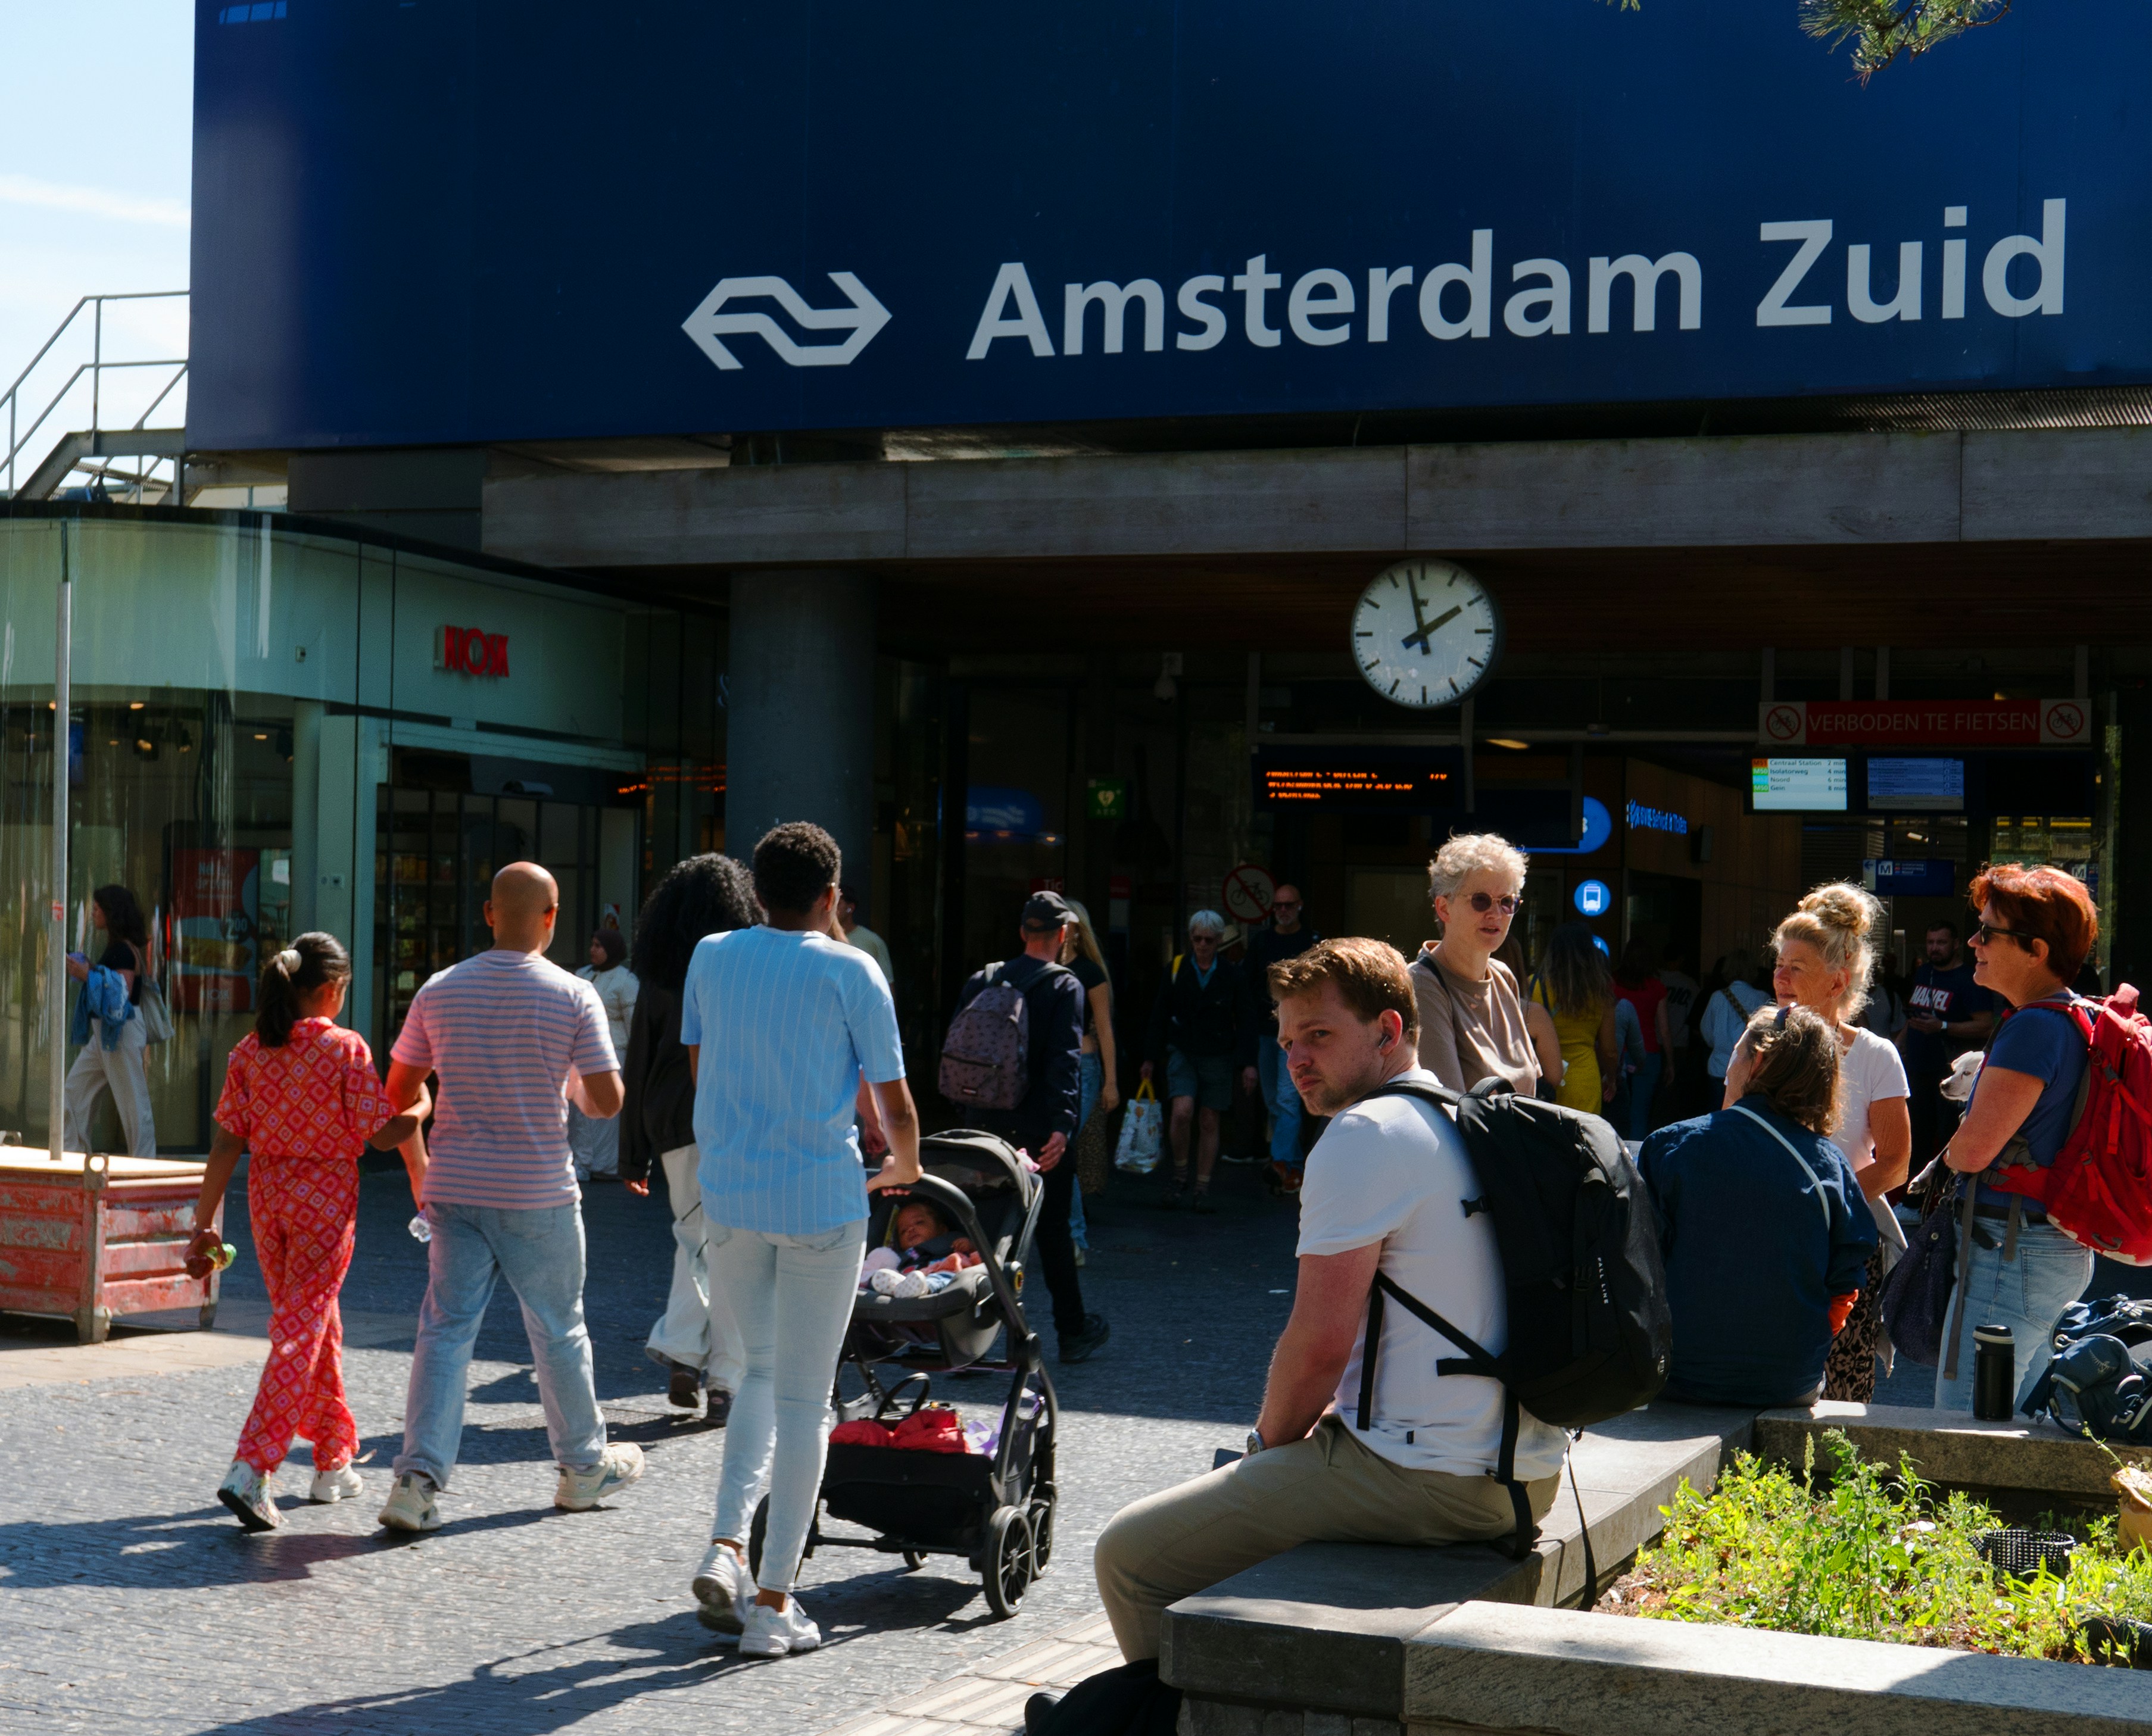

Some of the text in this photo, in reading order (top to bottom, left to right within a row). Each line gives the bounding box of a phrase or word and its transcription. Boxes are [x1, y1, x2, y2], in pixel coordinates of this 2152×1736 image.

[965, 198, 2066, 360] Amsterdam Zuid
[444, 625, 510, 677] KIOSK
[1808, 711, 2037, 732] VERBODEN TE FIETSEN
